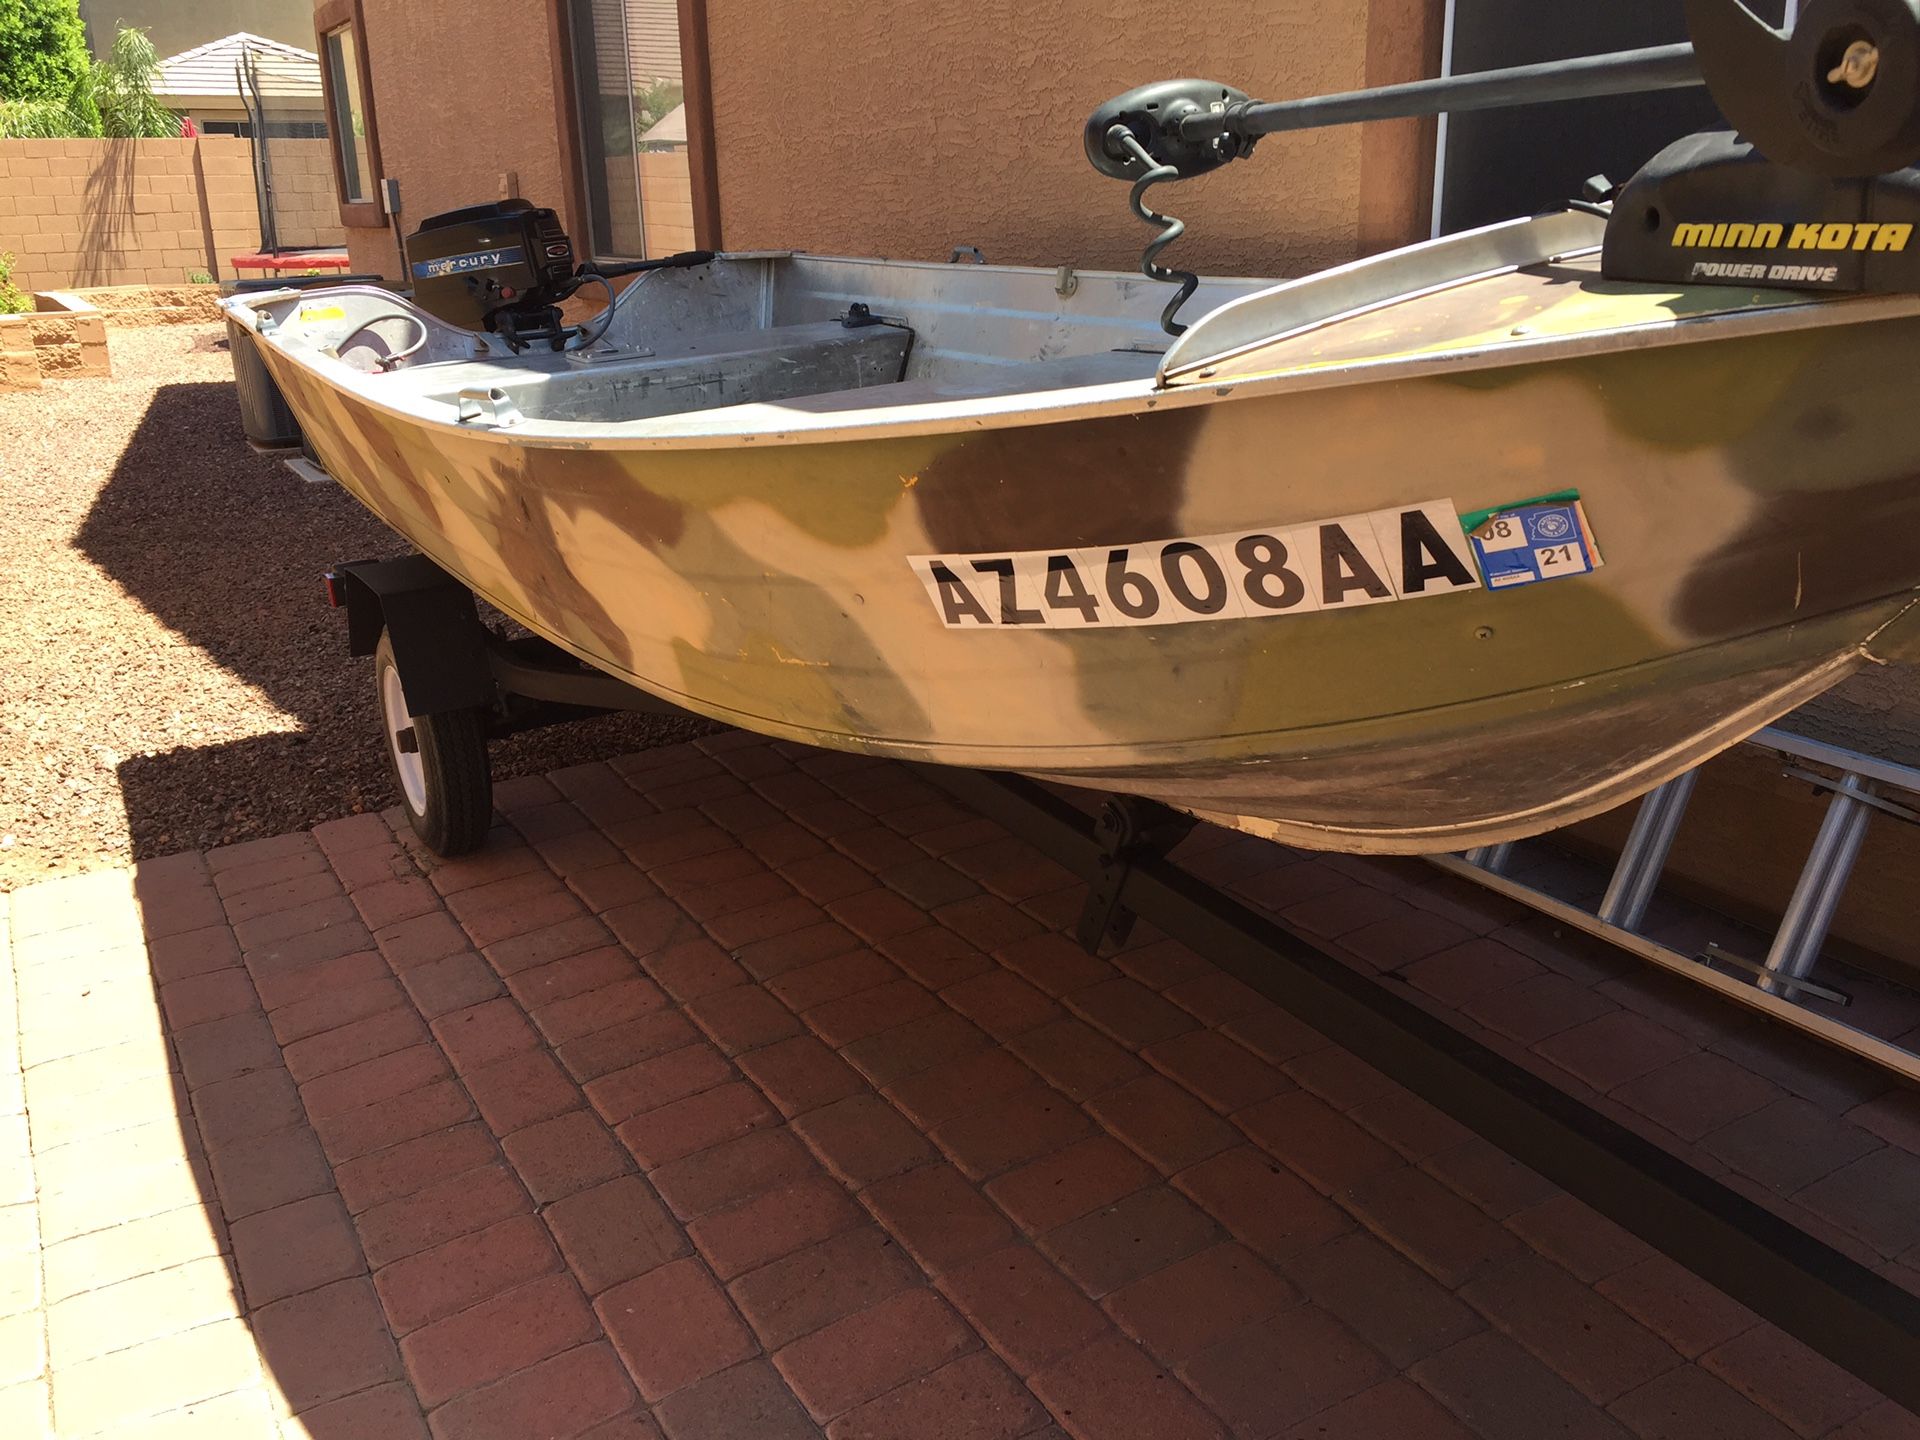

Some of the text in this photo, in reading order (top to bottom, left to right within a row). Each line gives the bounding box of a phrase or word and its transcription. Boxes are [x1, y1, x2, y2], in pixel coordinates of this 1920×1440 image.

[1671, 223, 1914, 251] MINN KOTA
[428, 253, 501, 273] mercury
[1692, 262, 1838, 282] POWER DRIVE
[1541, 545, 1572, 566] 21
[928, 510, 1476, 625] AZ4608AA
